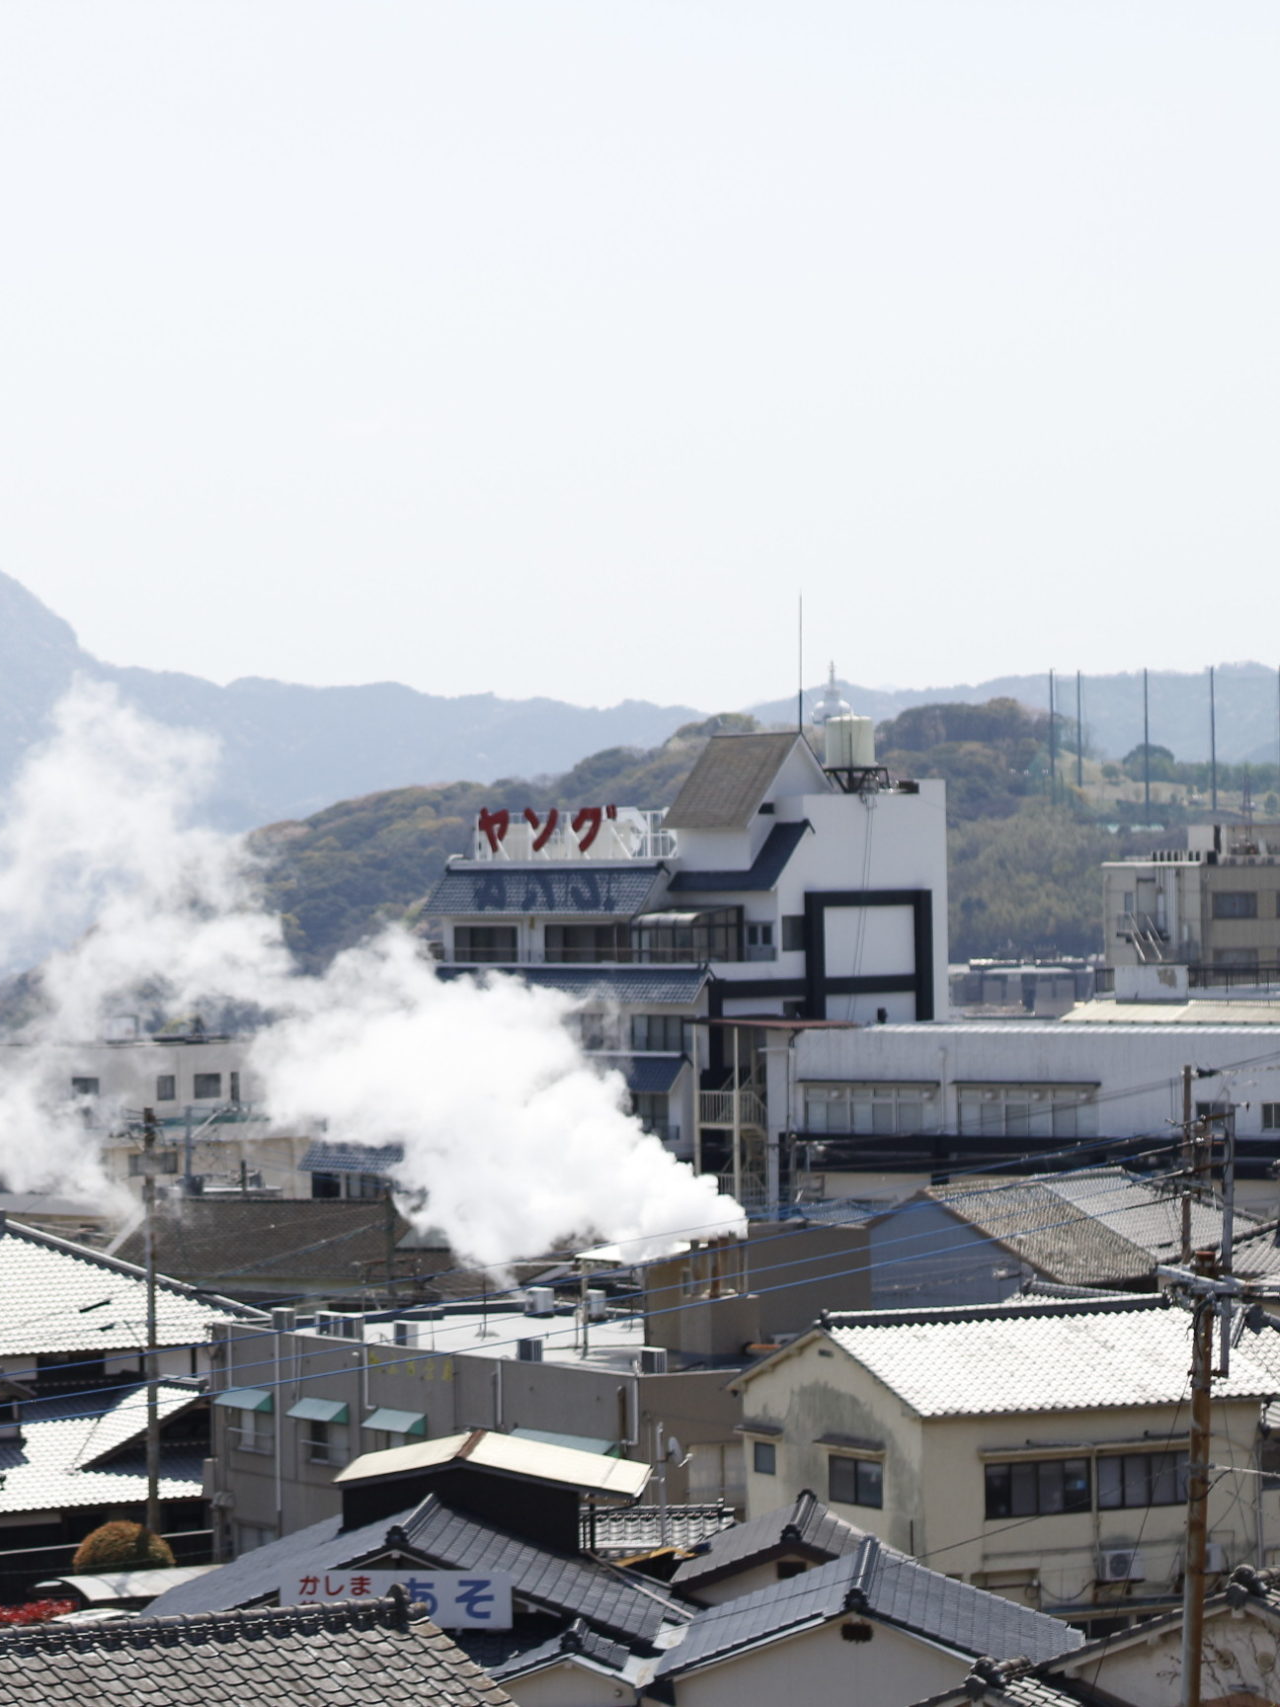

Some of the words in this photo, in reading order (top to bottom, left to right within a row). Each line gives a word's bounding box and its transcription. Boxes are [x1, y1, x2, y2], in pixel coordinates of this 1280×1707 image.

[479, 804, 617, 853] ヤング
[299, 1575, 372, 1596] かしま
